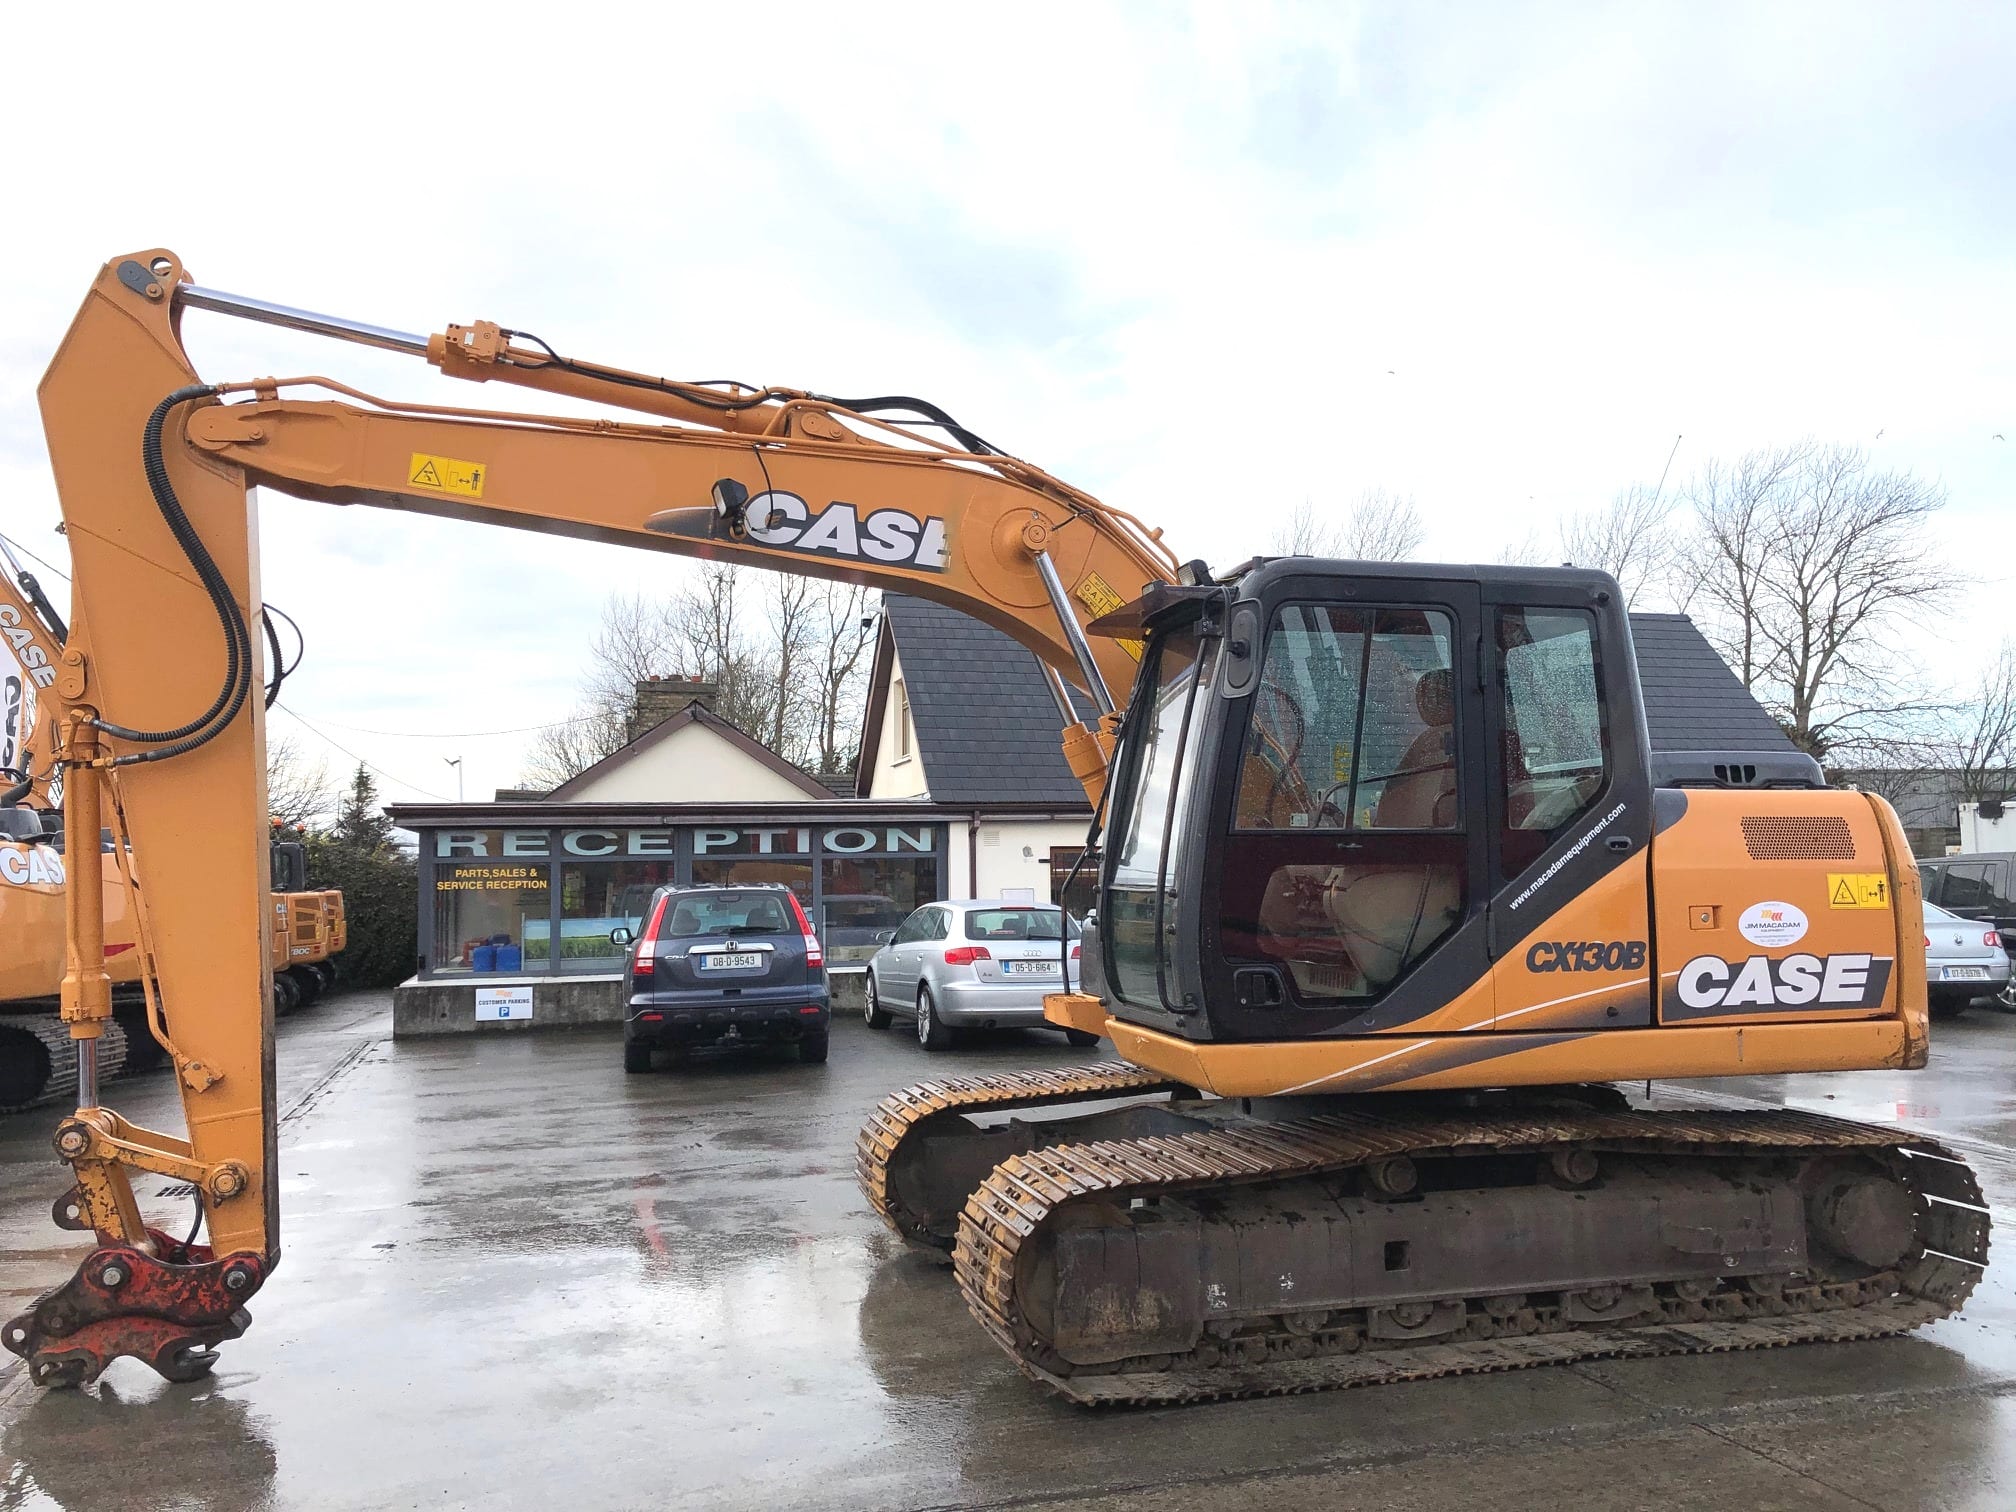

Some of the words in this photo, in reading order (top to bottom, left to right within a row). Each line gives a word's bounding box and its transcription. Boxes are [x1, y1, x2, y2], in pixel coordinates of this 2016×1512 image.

[744, 491, 950, 570] CASE
[0, 604, 57, 689] CASE
[437, 827, 932, 857] RECEPTION
[1509, 802, 1627, 911] www.macadamequipment.com
[0, 847, 65, 885] CAS
[530, 868, 538, 877] &
[436, 881, 484, 890] SERVICE
[486, 880, 547, 890] RECEPTION
[713, 956, 756, 967] 08-D-9543
[1526, 941, 1647, 973] CX130B
[1677, 953, 1873, 1008] CASE
